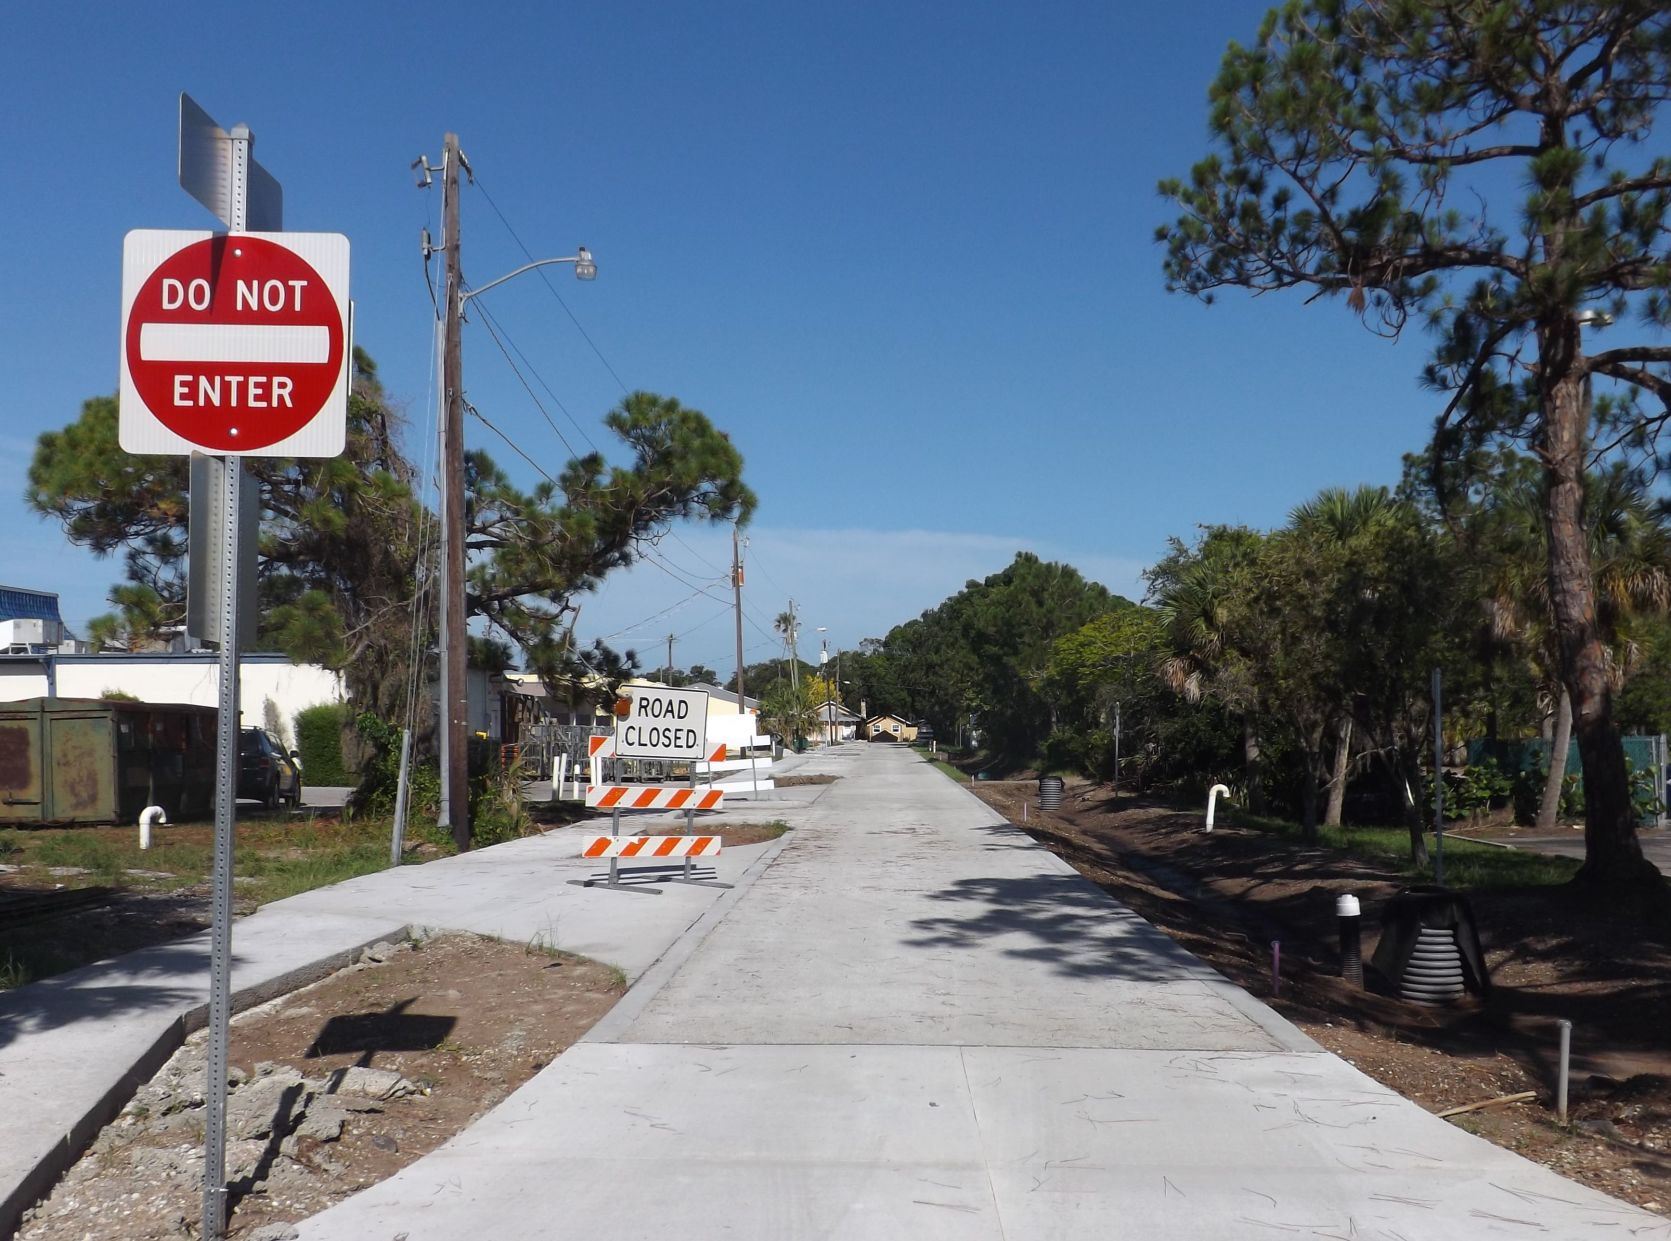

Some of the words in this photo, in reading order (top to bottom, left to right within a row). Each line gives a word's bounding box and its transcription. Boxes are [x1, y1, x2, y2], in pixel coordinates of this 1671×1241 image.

[161, 277, 212, 312] DO
[236, 278, 308, 313] NOT
[173, 374, 294, 408] ENTER
[638, 696, 689, 720] ROAD
[624, 725, 697, 749] CLOSED
